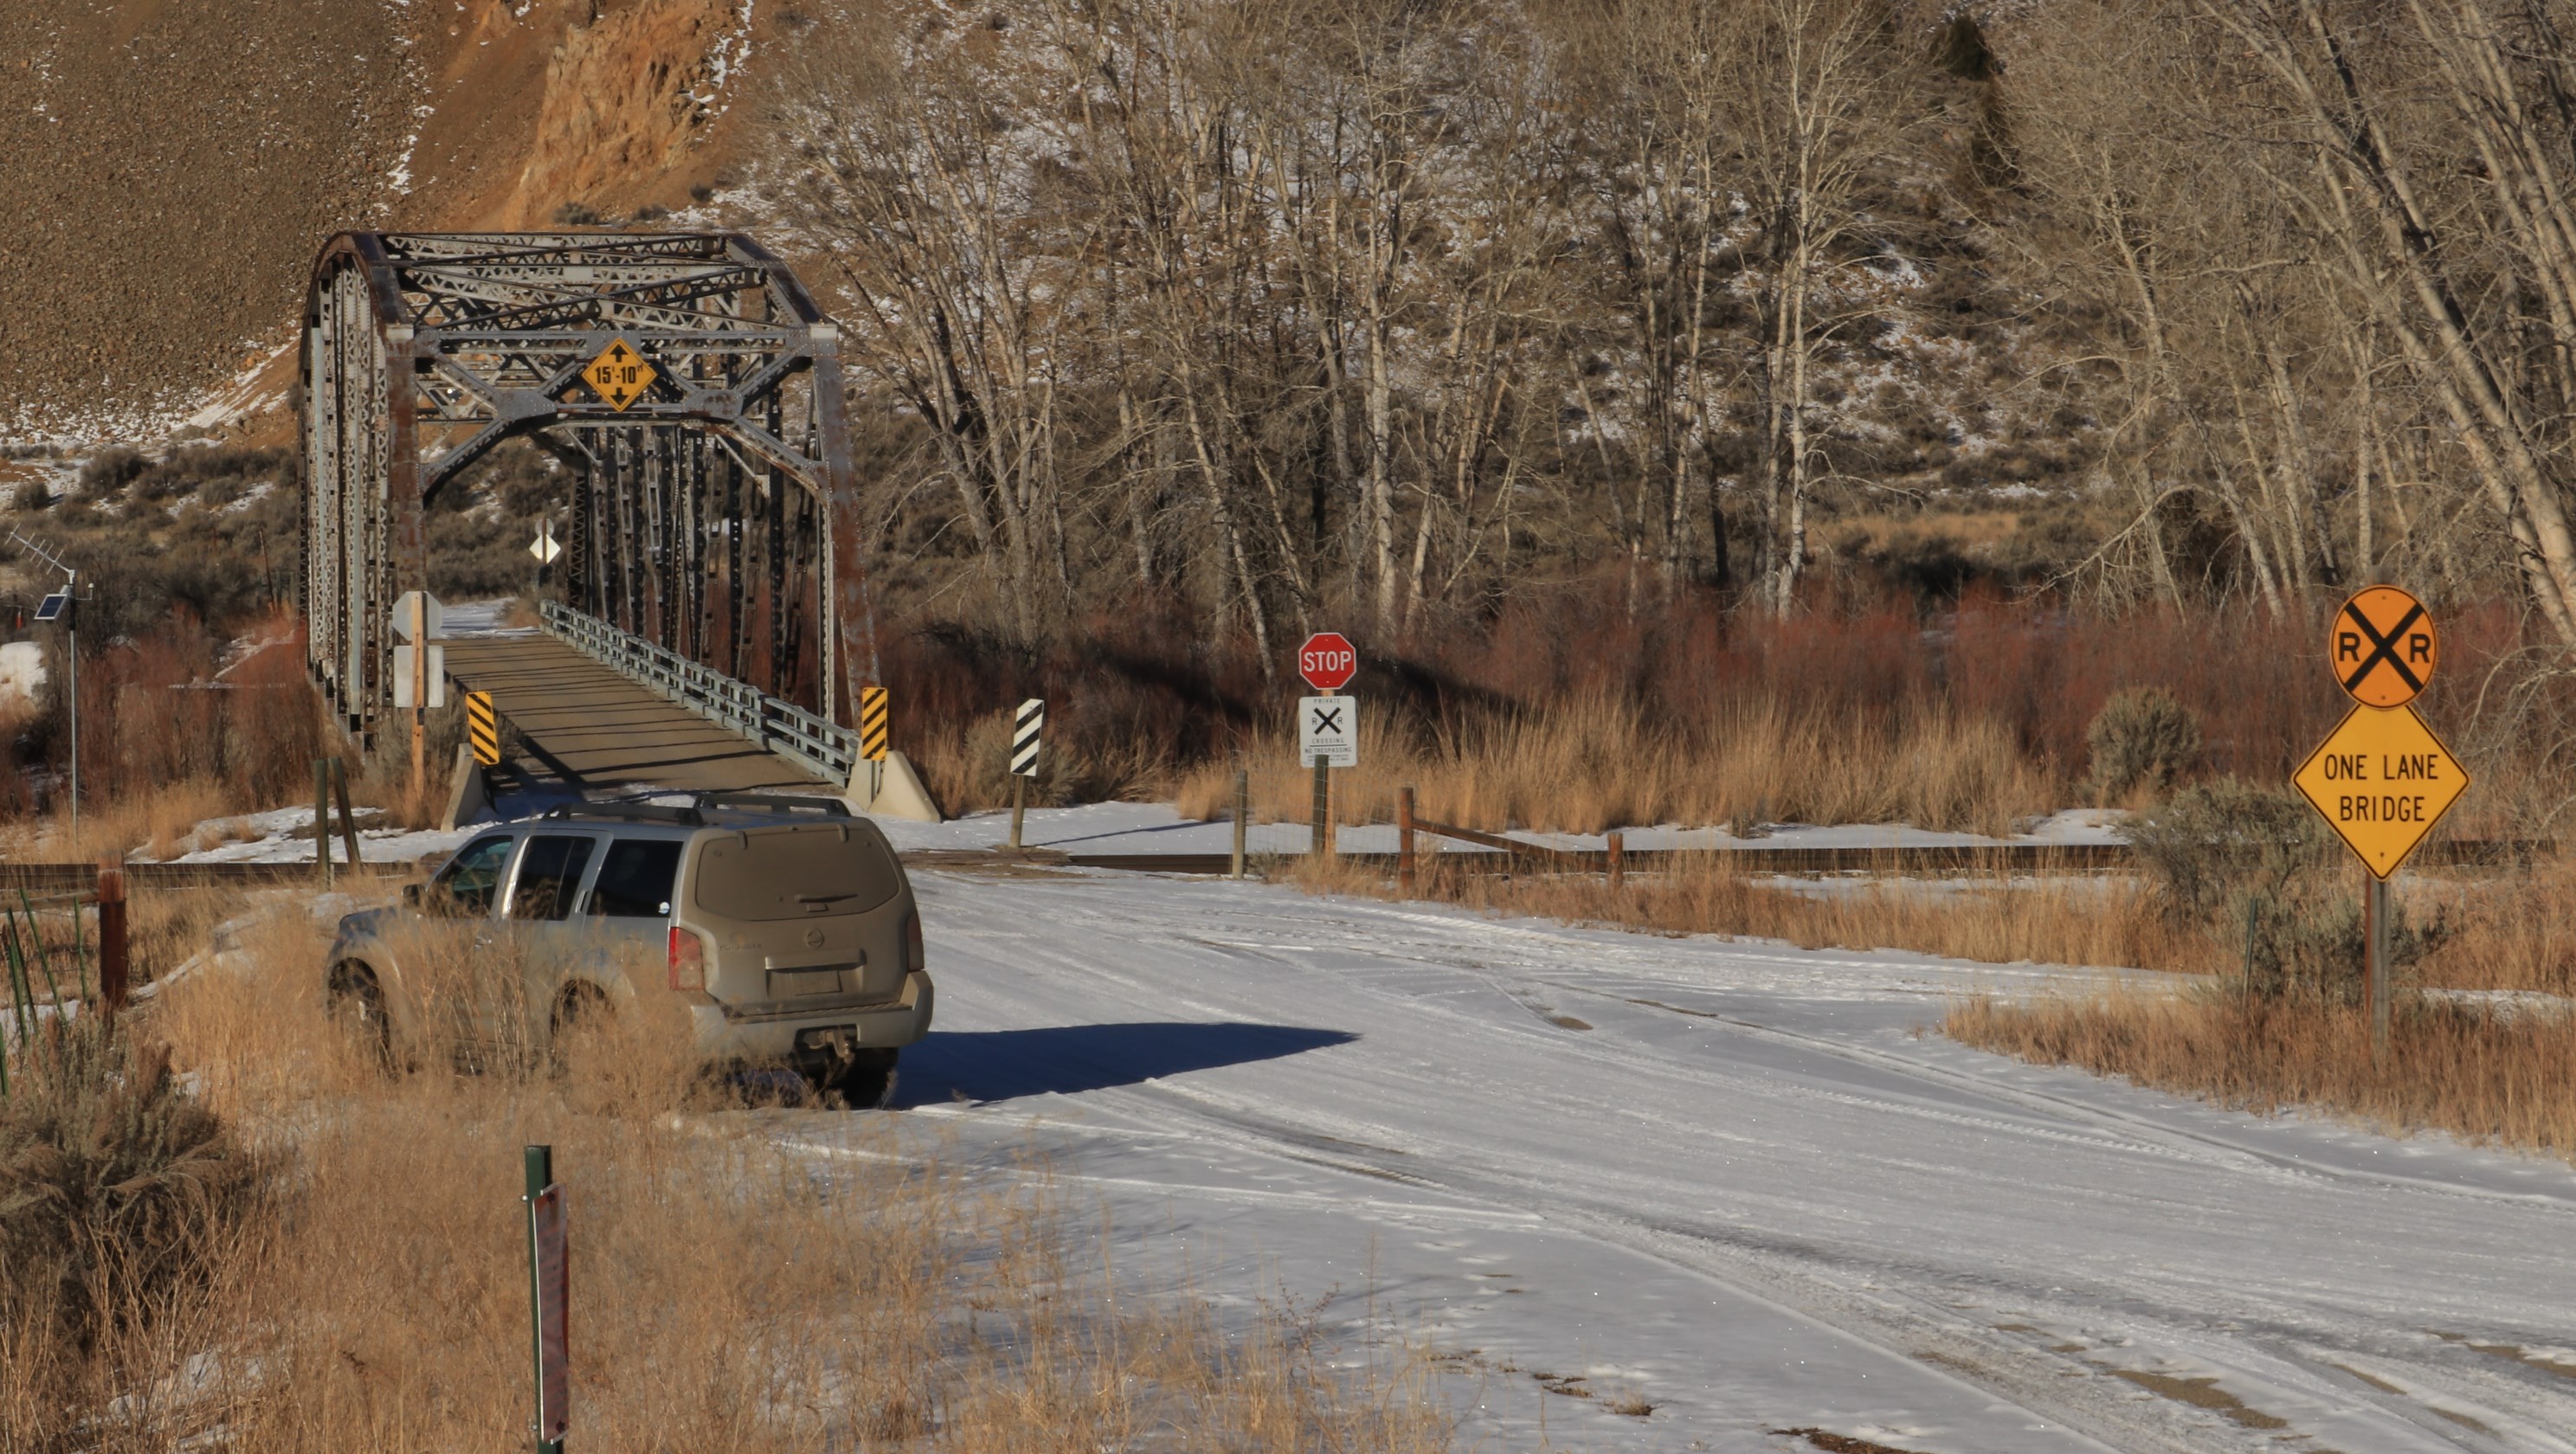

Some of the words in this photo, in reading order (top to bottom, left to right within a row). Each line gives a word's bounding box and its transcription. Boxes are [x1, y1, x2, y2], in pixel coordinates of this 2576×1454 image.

[2338, 632, 2360, 662] R
[2409, 633, 2431, 663] R
[1304, 651, 1352, 672] STOP
[2325, 754, 2367, 780] ONE
[2384, 754, 2438, 780] LANE
[2340, 796, 2425, 822] BRIDGE
